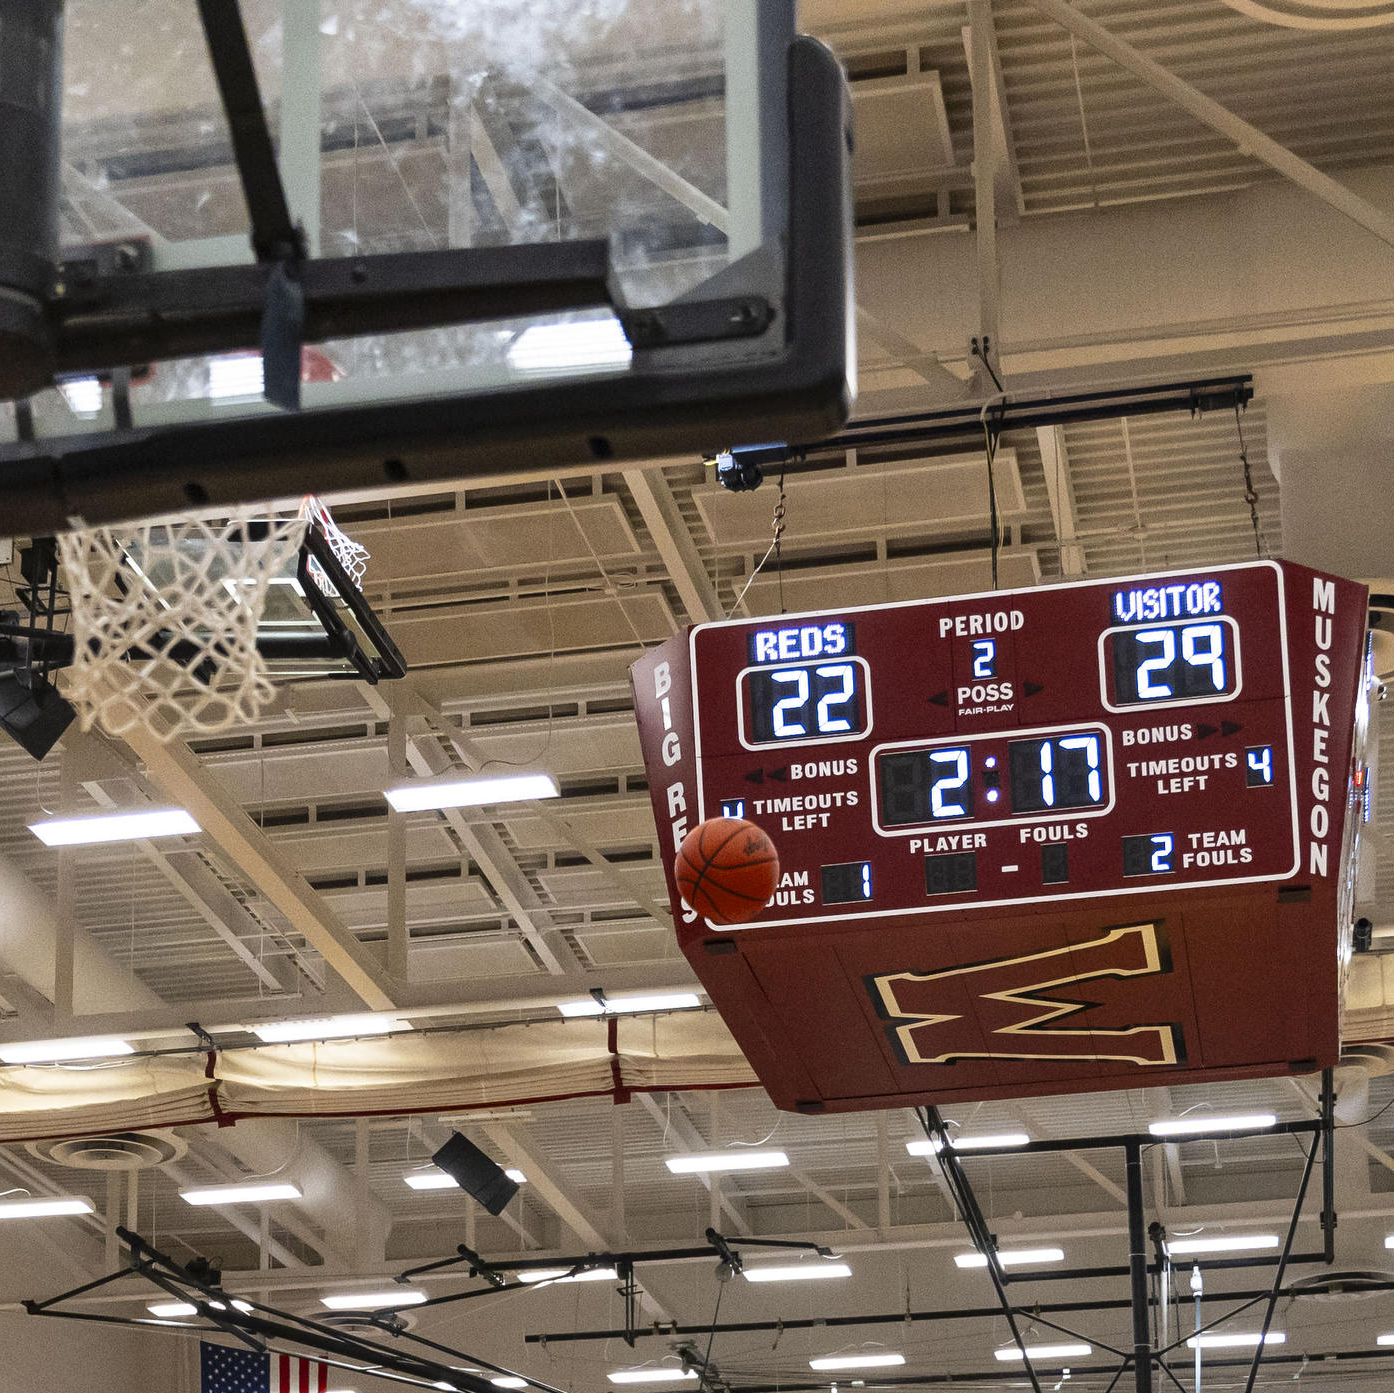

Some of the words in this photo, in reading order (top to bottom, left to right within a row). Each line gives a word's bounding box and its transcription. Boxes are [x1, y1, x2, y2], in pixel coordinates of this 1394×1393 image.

[1115, 581, 1222, 622] VISITOR
[939, 610, 1025, 638] PERIOD
[755, 623, 847, 662] REDS
[973, 639, 996, 678] 2
[1135, 624, 1226, 698] 29
[771, 664, 855, 737] 22
[957, 682, 1014, 704] POSS
[654, 660, 682, 767] BIG
[958, 704, 1015, 716] FAIR-PLAY
[1122, 723, 1193, 746] BONUS
[1310, 577, 1335, 877] MUSKEGON
[790, 759, 858, 780] BONUS
[929, 735, 1102, 817] 2:17
[1127, 753, 1238, 777] TIMEOUTS
[1247, 747, 1273, 784] 4
[1157, 776, 1209, 795] LEFT
[753, 791, 859, 815] TIMEOUTS
[782, 813, 831, 832] LEFT
[1019, 823, 1089, 843] FOULS
[910, 834, 987, 854] PLAYER
[1150, 833, 1175, 873] 2
[1188, 829, 1246, 849] TEAM
[1182, 847, 1253, 869] FOULS
[861, 863, 872, 898] 1
[867, 920, 1183, 1066] M
